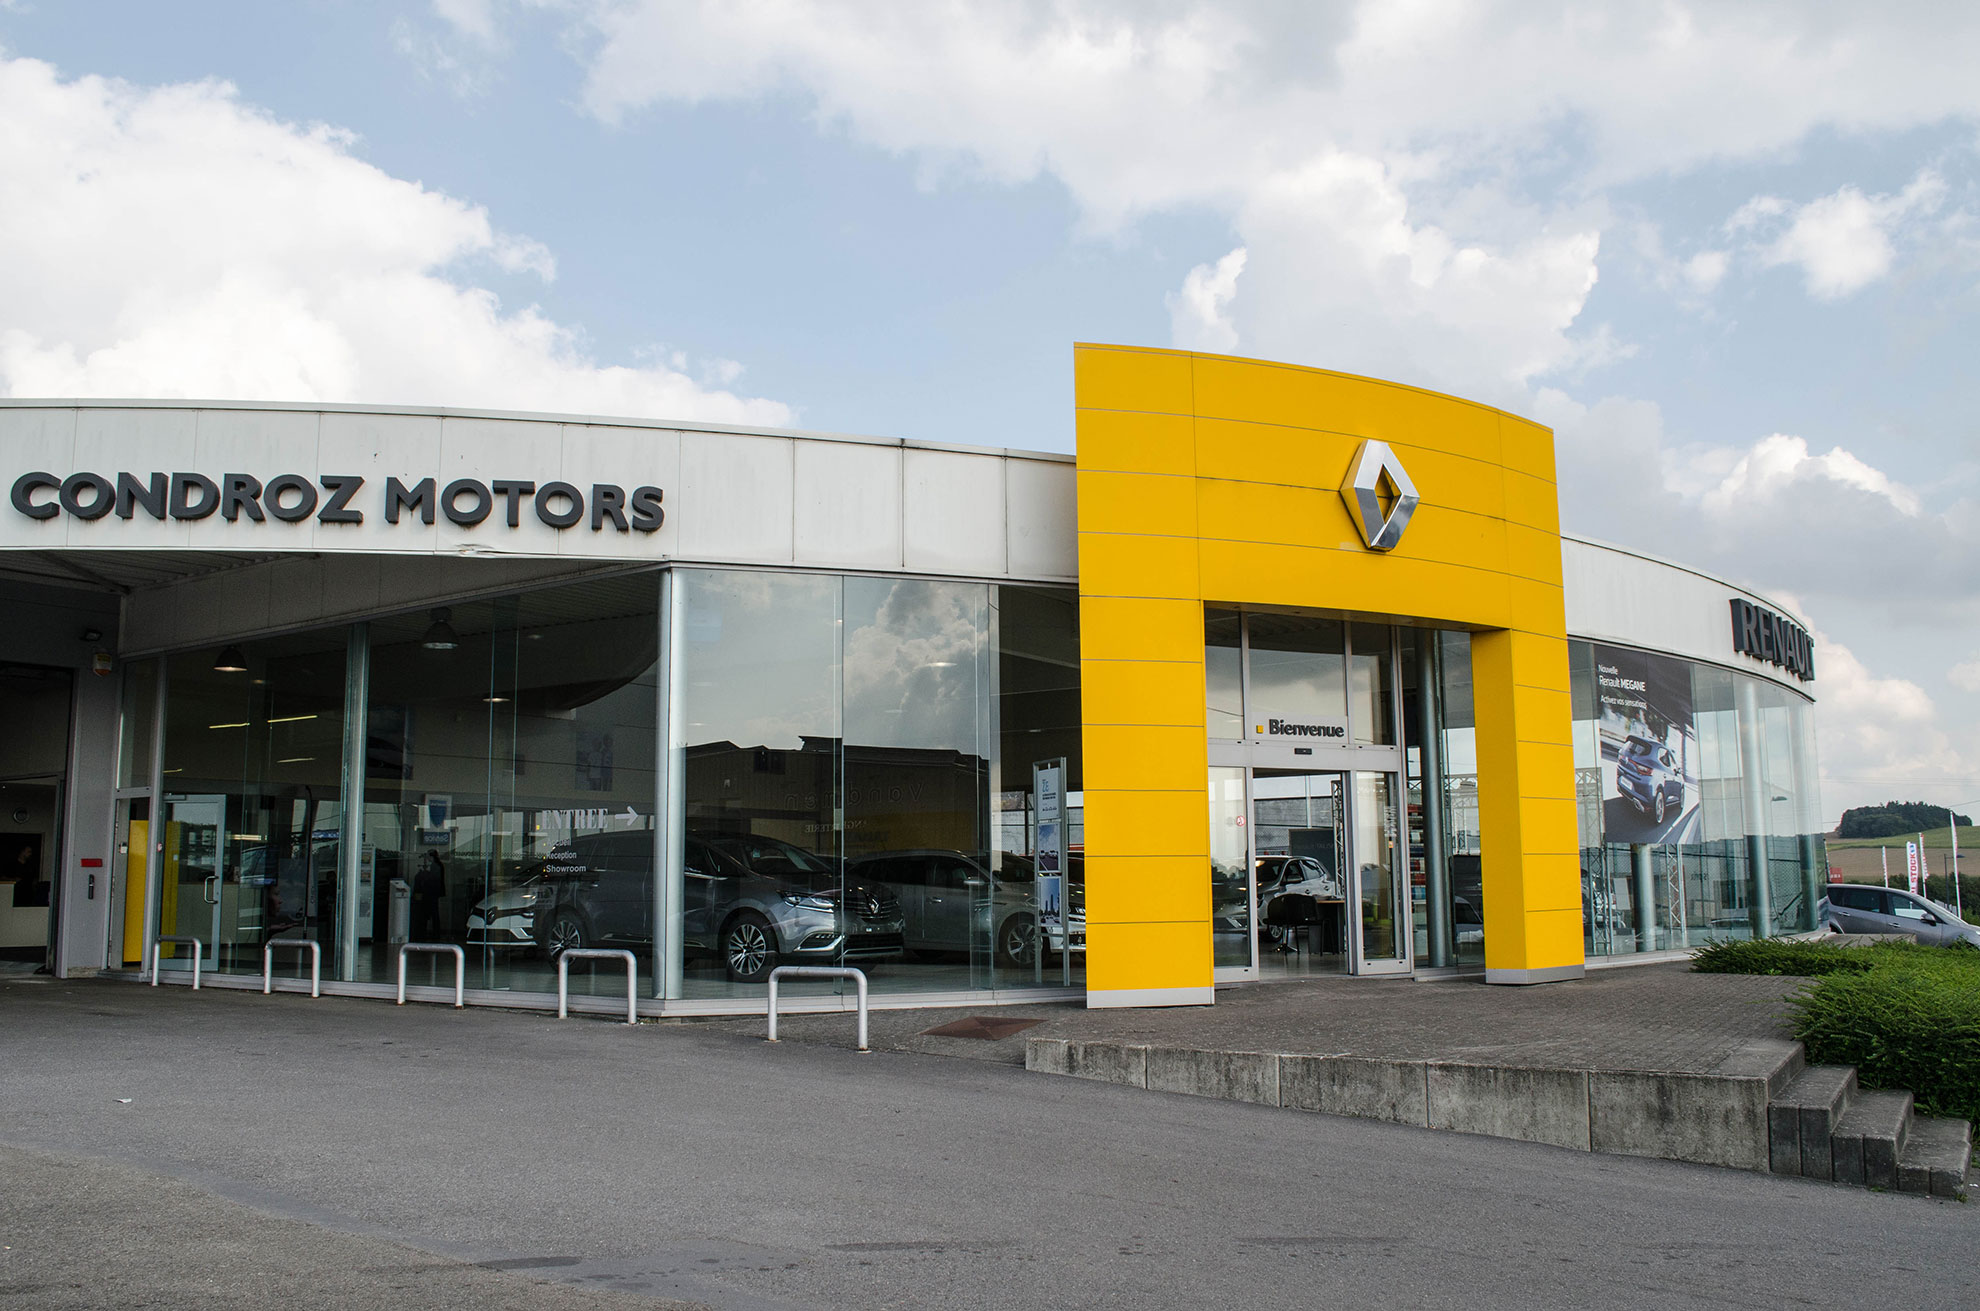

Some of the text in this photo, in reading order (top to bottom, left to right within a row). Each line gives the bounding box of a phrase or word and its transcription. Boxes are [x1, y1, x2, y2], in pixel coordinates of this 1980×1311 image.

[10, 471, 665, 531] CONDROZ MOTORS
[1729, 598, 1815, 681] RENAULT
[1598, 664, 1618, 675] Nouvelle
[1599, 675, 1620, 688] Renault
[1269, 719, 1344, 737] Bienvenue
[547, 851, 577, 861] Reception
[546, 864, 586, 873] Showroom
